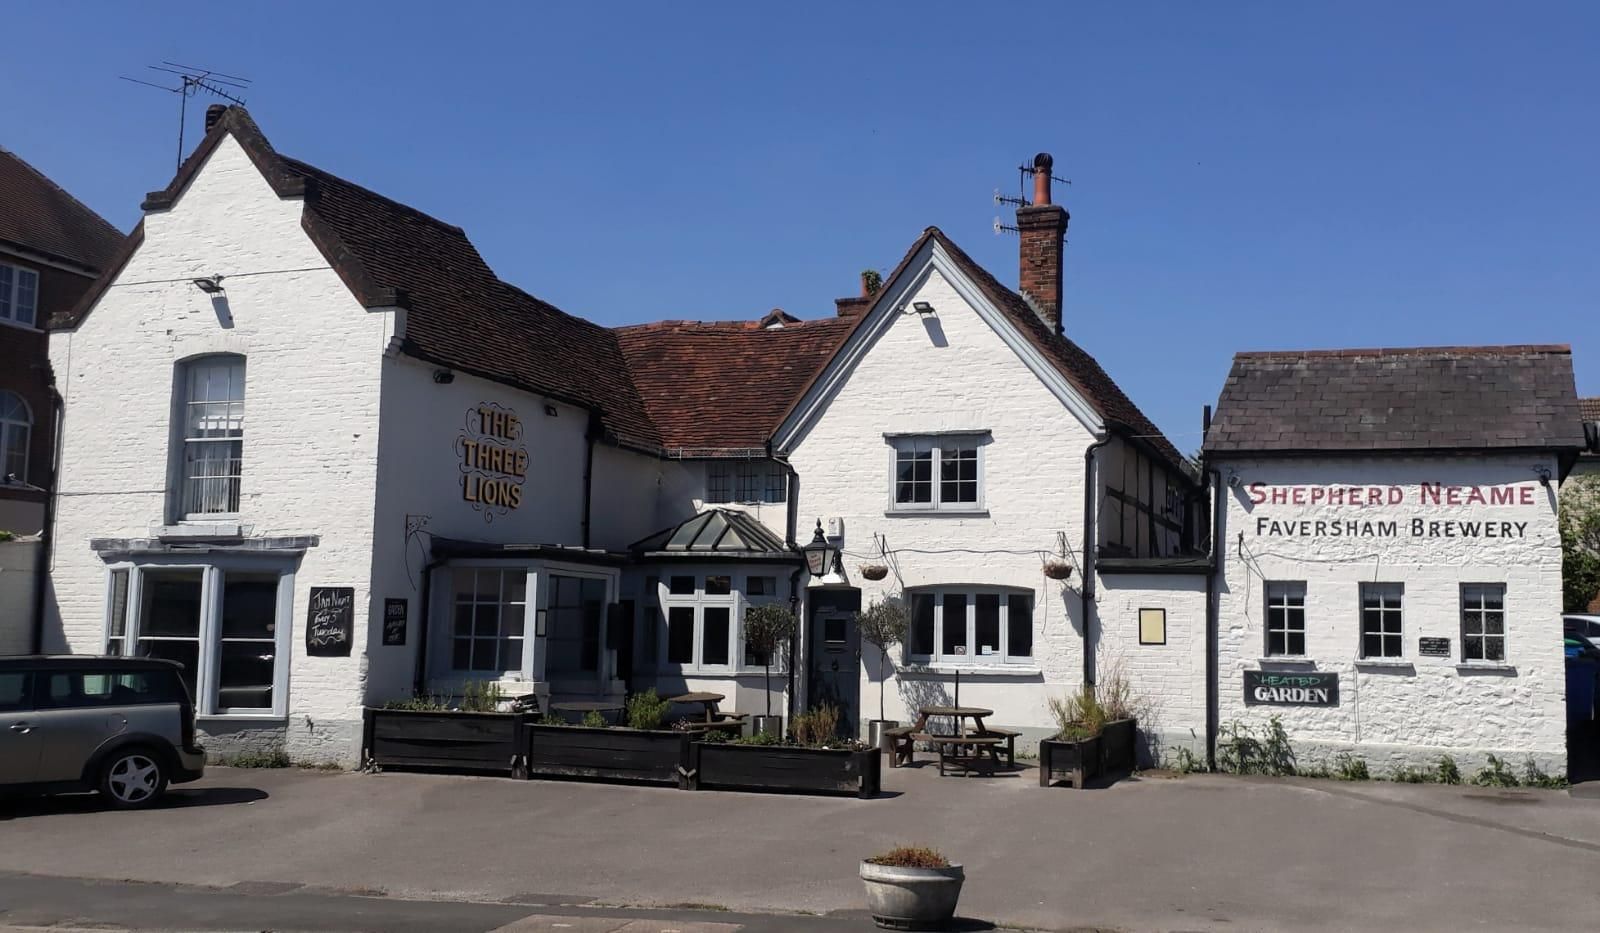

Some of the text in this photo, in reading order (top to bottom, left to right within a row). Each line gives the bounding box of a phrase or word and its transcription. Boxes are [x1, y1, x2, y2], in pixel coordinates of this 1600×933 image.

[478, 407, 517, 440] THE
[462, 438, 526, 477] THREE
[463, 473, 521, 510] LIONS
[1250, 481, 1535, 505] SHEPHERD NEAME
[1256, 517, 1528, 538] FAVERSHAM BREWERY
[1254, 686, 1328, 703] GARDEN
